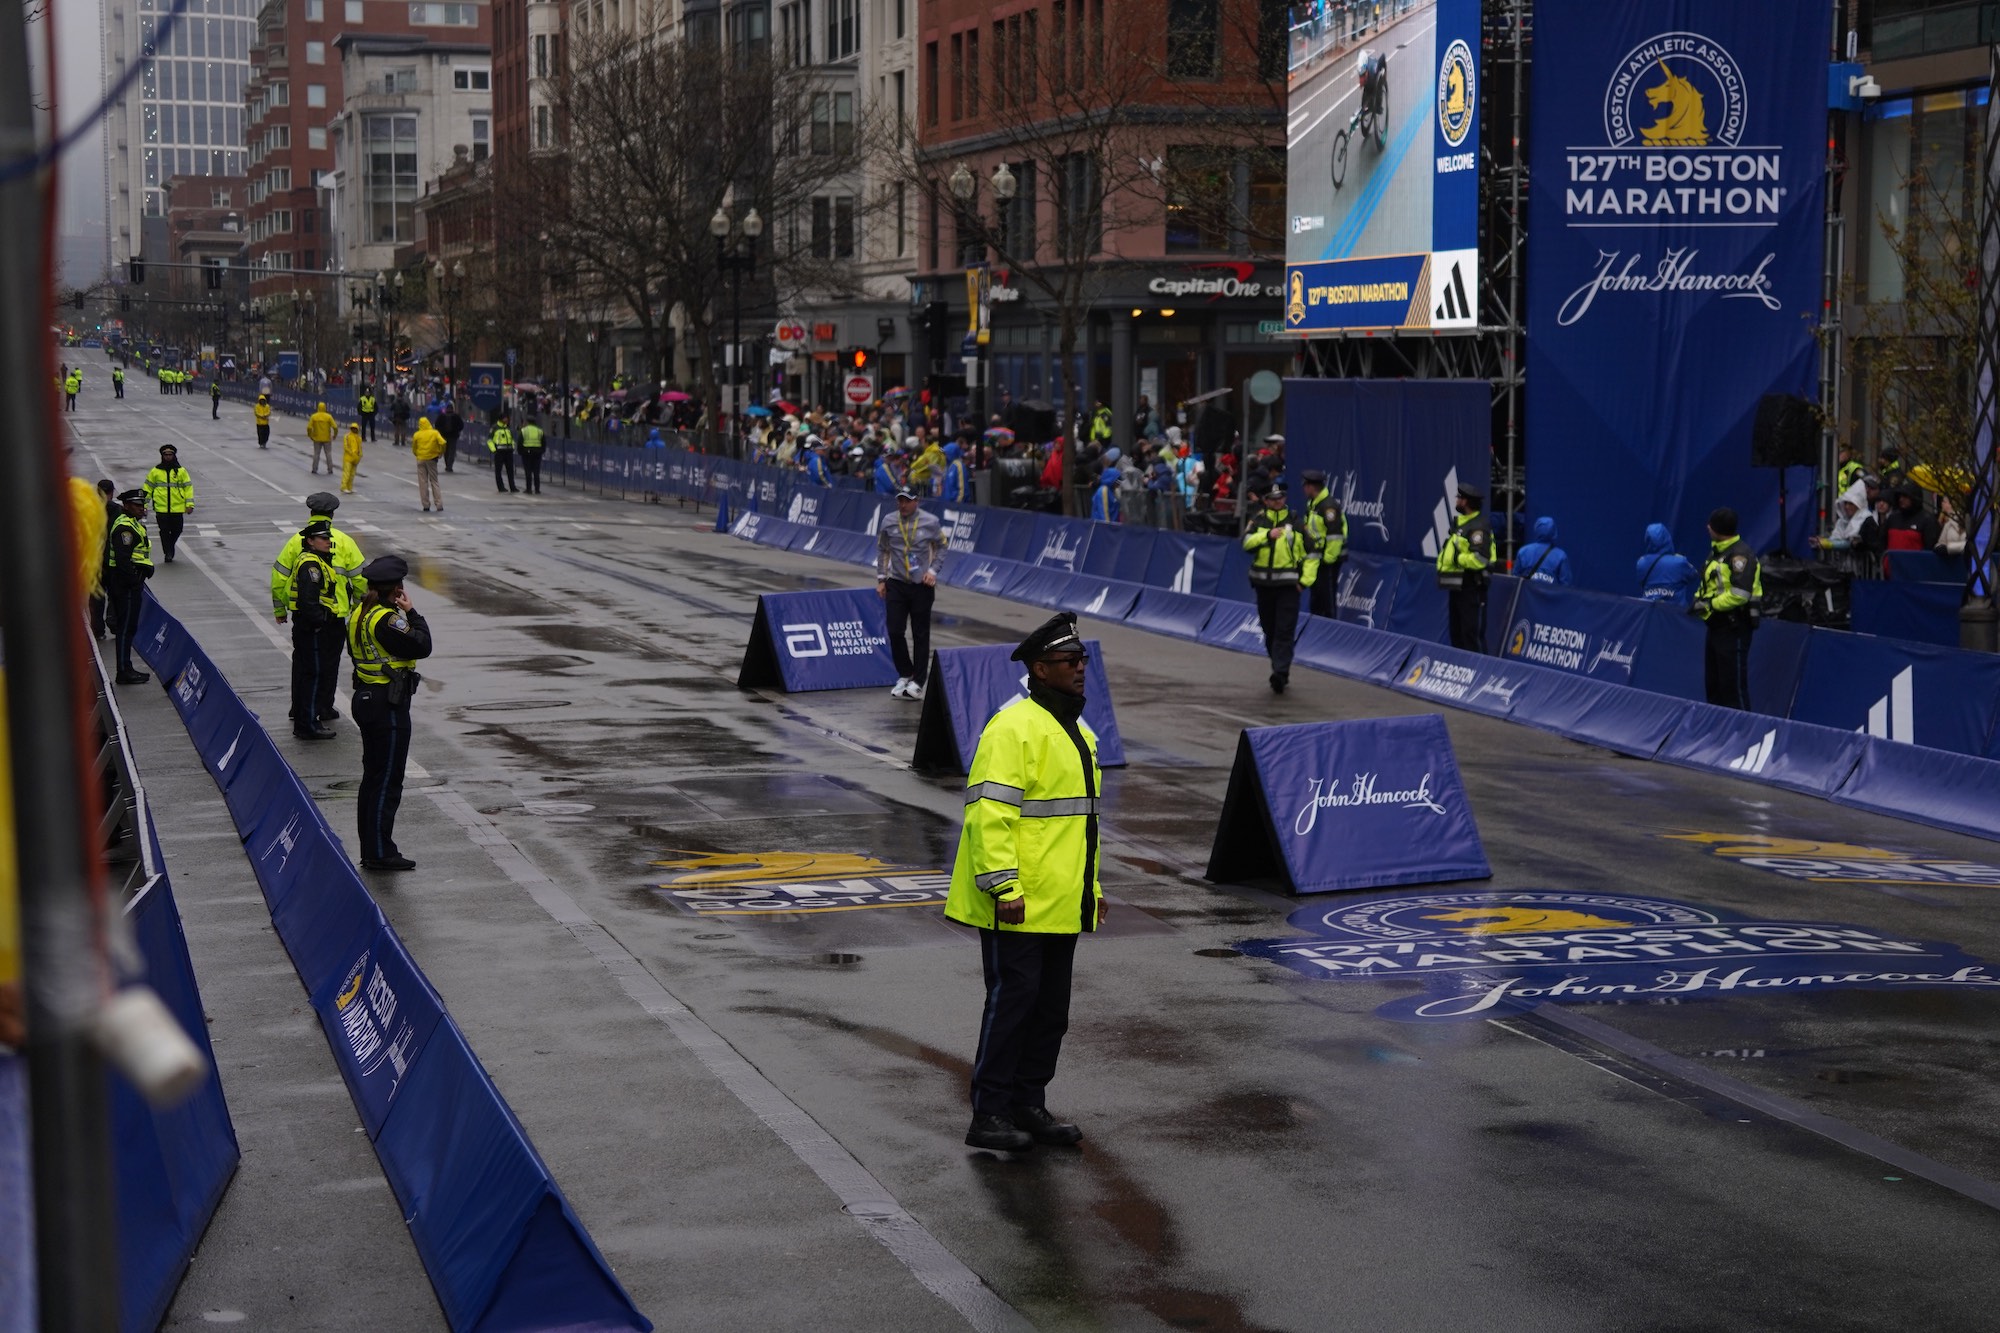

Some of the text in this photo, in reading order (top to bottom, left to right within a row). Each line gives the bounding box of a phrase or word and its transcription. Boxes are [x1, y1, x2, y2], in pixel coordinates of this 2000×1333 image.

[1611, 38, 1742, 141] BOSTON ATHLETIC ASSOCIATION
[1436, 152, 1475, 174] WELCOME
[1566, 155, 1780, 182] 127TH BOSTON
[1566, 187, 1779, 215] MARATHON
[1265, 283, 1287, 297] caf
[1308, 282, 1408, 306] 127TH BOSTON MARATHON
[1558, 246, 1782, 326] John Hancock
[1341, 470, 1390, 542] Hancock
[1532, 572, 1555, 584] STON
[827, 621, 863, 631] ABBOTT
[828, 630, 863, 639] WORLD
[1533, 623, 1552, 642] THE
[1551, 627, 1586, 650] BOSTON
[831, 637, 887, 647] MARATHON
[834, 646, 873, 656] MAJORS
[1526, 643, 1581, 670] MARATHON
[1429, 660, 1446, 677] THE
[1444, 663, 1477, 684] BOSTON
[1418, 677, 1469, 699] MARATHON
[1295, 771, 1447, 835] John Hancock
[672, 874, 952, 900] ONE
[1775, 868, 2000, 885] BOSTO
[686, 890, 949, 910] BOSTO
[1279, 926, 1882, 958] 127TH BOSTON
[1308, 938, 1925, 969] MARATHON
[1414, 966, 2000, 1018] John Hancock
[340, 997, 382, 1064] MARATHON
